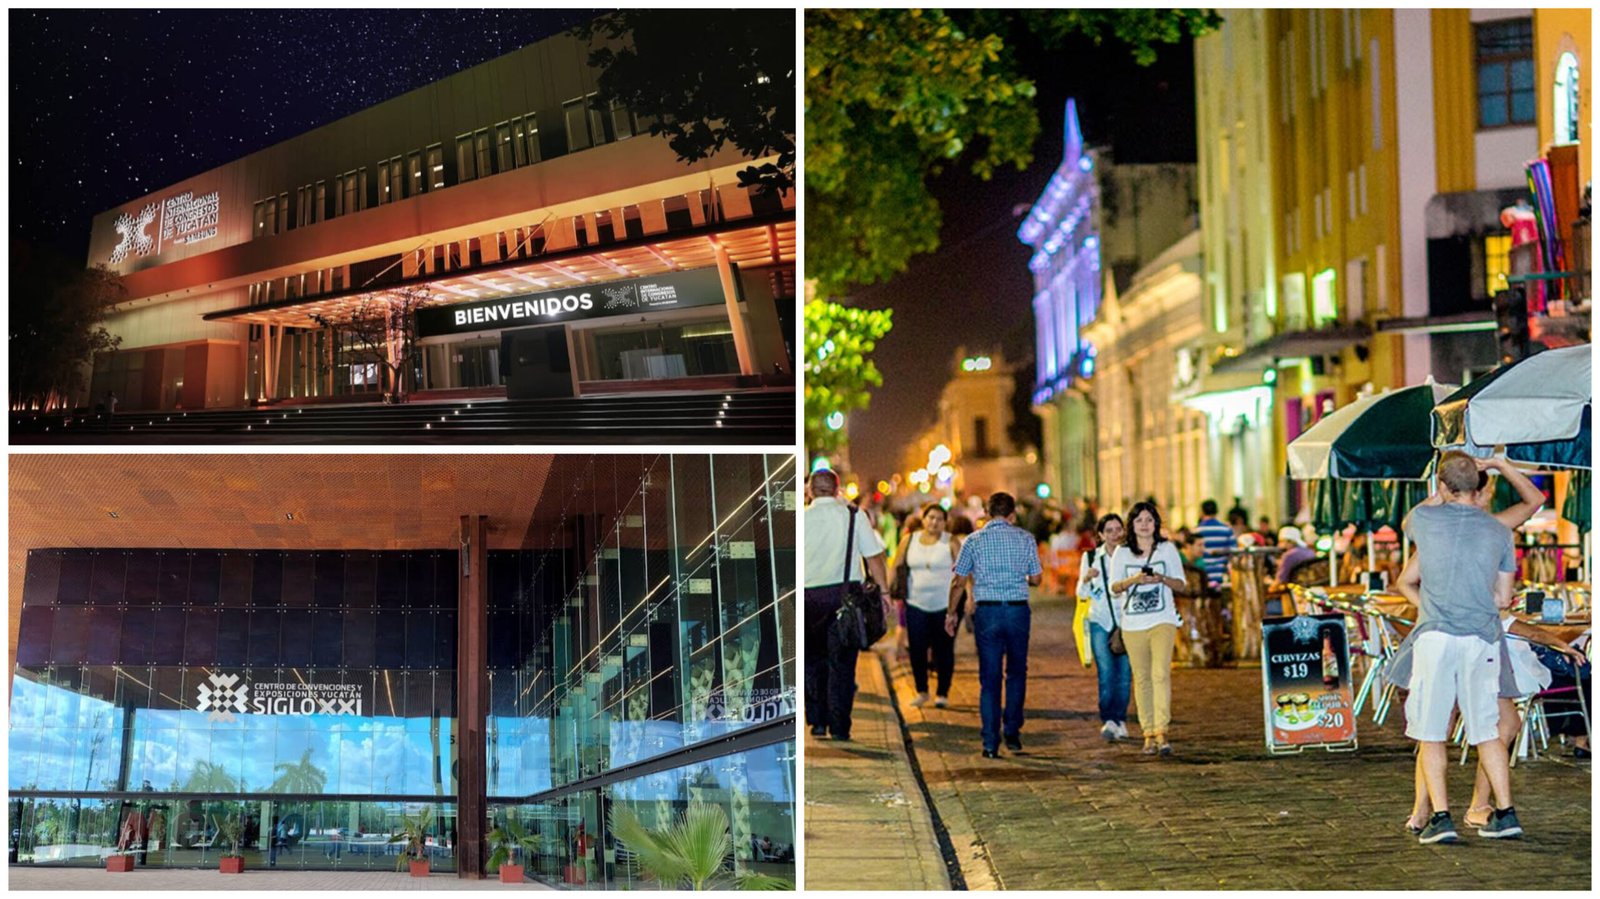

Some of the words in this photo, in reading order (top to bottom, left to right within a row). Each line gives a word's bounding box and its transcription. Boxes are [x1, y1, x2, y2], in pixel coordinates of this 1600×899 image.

[166, 192, 193, 207] CENTRO
[174, 202, 219, 224] CONGRESOS
[163, 229, 174, 241] DE
[184, 226, 218, 245] SAMSUNG
[455, 293, 593, 325] BIENVENIDOS
[1271, 653, 1320, 663] CERVEZAS
[1283, 663, 1309, 678] $19
[254, 690, 318, 698] EXPOSICIONES
[297, 683, 356, 691] CONVENCIONES
[1317, 712, 1344, 728] $20
